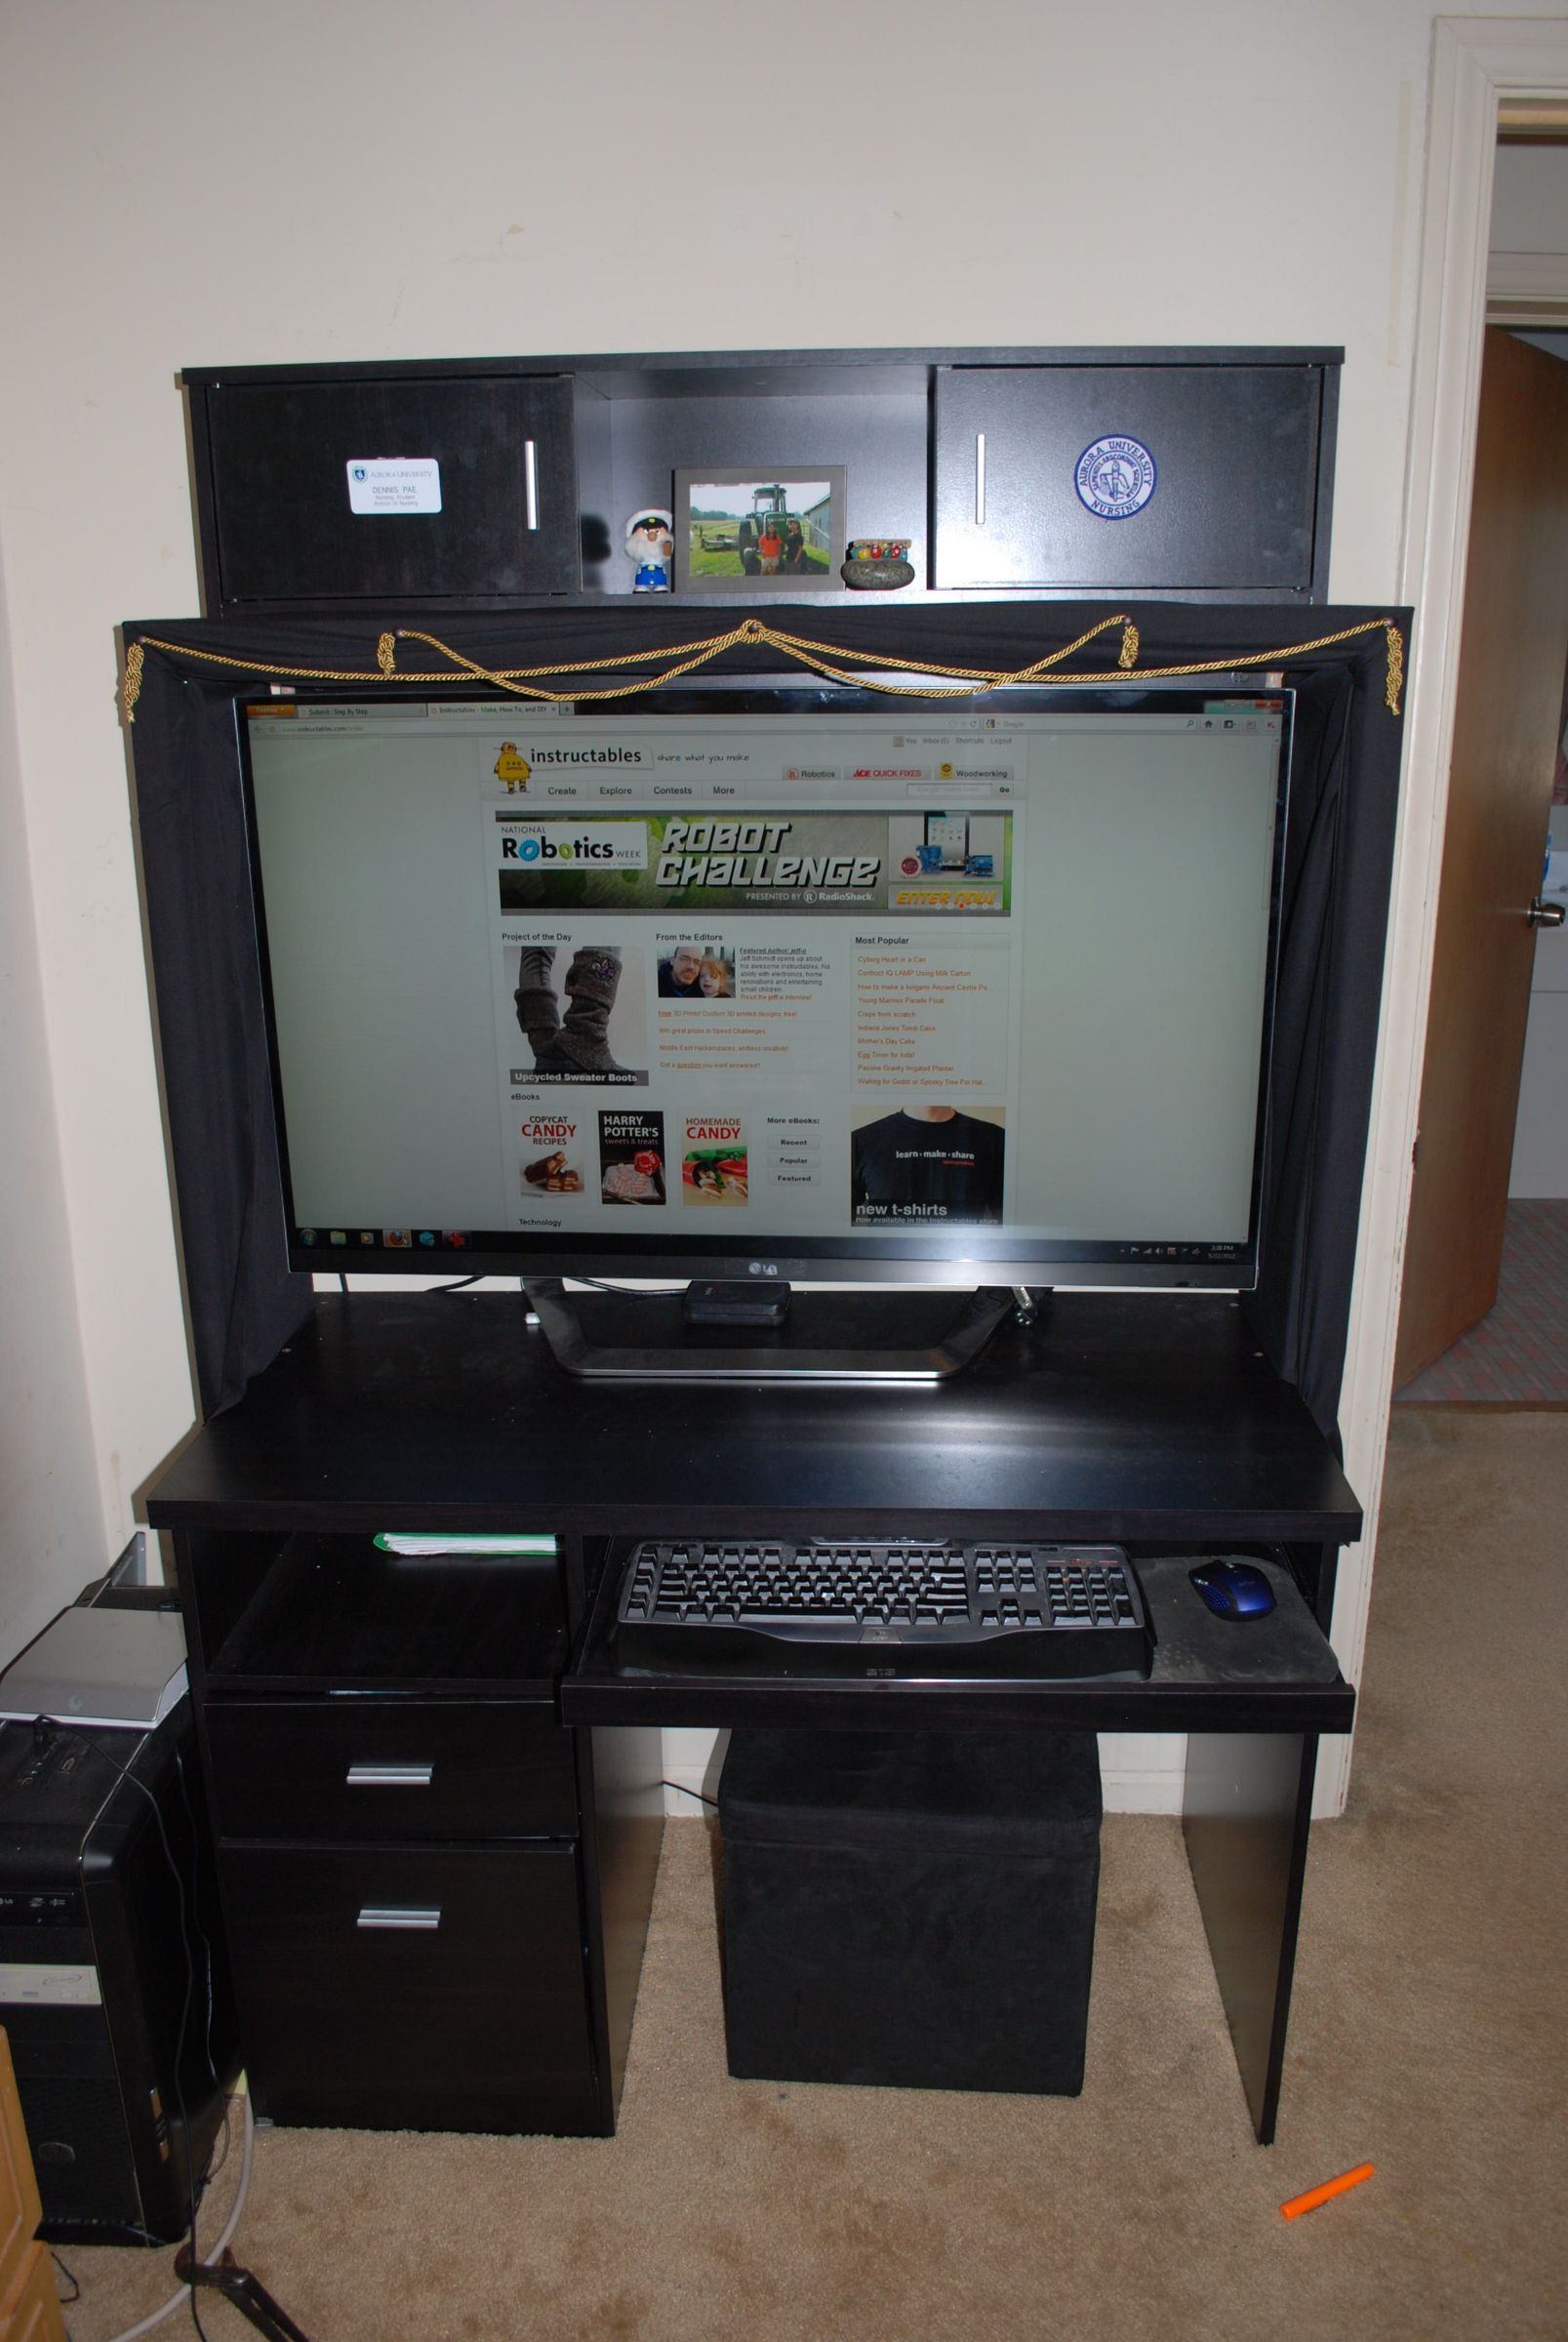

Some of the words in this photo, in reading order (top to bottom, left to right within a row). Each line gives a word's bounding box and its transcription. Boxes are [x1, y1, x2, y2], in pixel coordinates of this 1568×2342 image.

[1079, 446, 1105, 487] AURORA
[1107, 440, 1152, 487] UNIVERSITY
[1091, 500, 1140, 516] NURSING
[531, 747, 642, 764] instructables
[657, 753, 681, 762] share
[685, 753, 704, 762] what
[708, 754, 726, 765] you
[727, 753, 749, 762] make
[801, 769, 836, 779] Robotics
[853, 769, 871, 778] ACE
[873, 769, 899, 778] QUICK
[956, 769, 1008, 780] Woodworking
[547, 787, 577, 795] Create
[600, 787, 632, 796] Explore
[654, 786, 692, 795] Contests
[713, 787, 735, 795] More
[501, 826, 546, 834] NATIONAL
[662, 821, 792, 854] ROBOT
[502, 836, 614, 862] Robotics
[616, 850, 641, 859] WEEK
[745, 892, 789, 902] PRESENTED
[791, 892, 801, 902] BY
[896, 889, 952, 906] ENTER
[502, 933, 531, 942] Project
[532, 933, 541, 942] of
[543, 933, 555, 942] the
[557, 933, 572, 943] Day
[656, 933, 677, 942] From
[679, 933, 692, 942] the
[694, 933, 723, 943] Editors
[855, 936, 875, 945] Most
[877, 936, 909, 947] Popular
[514, 1072, 562, 1083] Upcycled
[563, 1072, 607, 1082] Sweater
[608, 1073, 638, 1082] Boots
[510, 1093, 542, 1102] eBooks
[529, 1114, 569, 1125] COPYCAT
[604, 1115, 644, 1126] HARRY
[686, 1117, 742, 1127] HOMEMADE
[788, 1117, 821, 1126] eBooks:
[521, 1123, 578, 1138] CANDY
[604, 1126, 660, 1138] POTTER'S
[686, 1126, 742, 1140] CANDY
[532, 1138, 568, 1147] RECIPES
[896, 1150, 919, 1159] learn
[923, 1150, 947, 1159] make
[951, 1150, 975, 1160] share
[780, 1156, 809, 1166] Popular
[856, 1203, 888, 1216] new
[892, 1202, 948, 1217] t-shirts
[519, 1218, 562, 1229] Technology
[872, 1216, 905, 1225] available
[763, 1264, 778, 1276] LG
